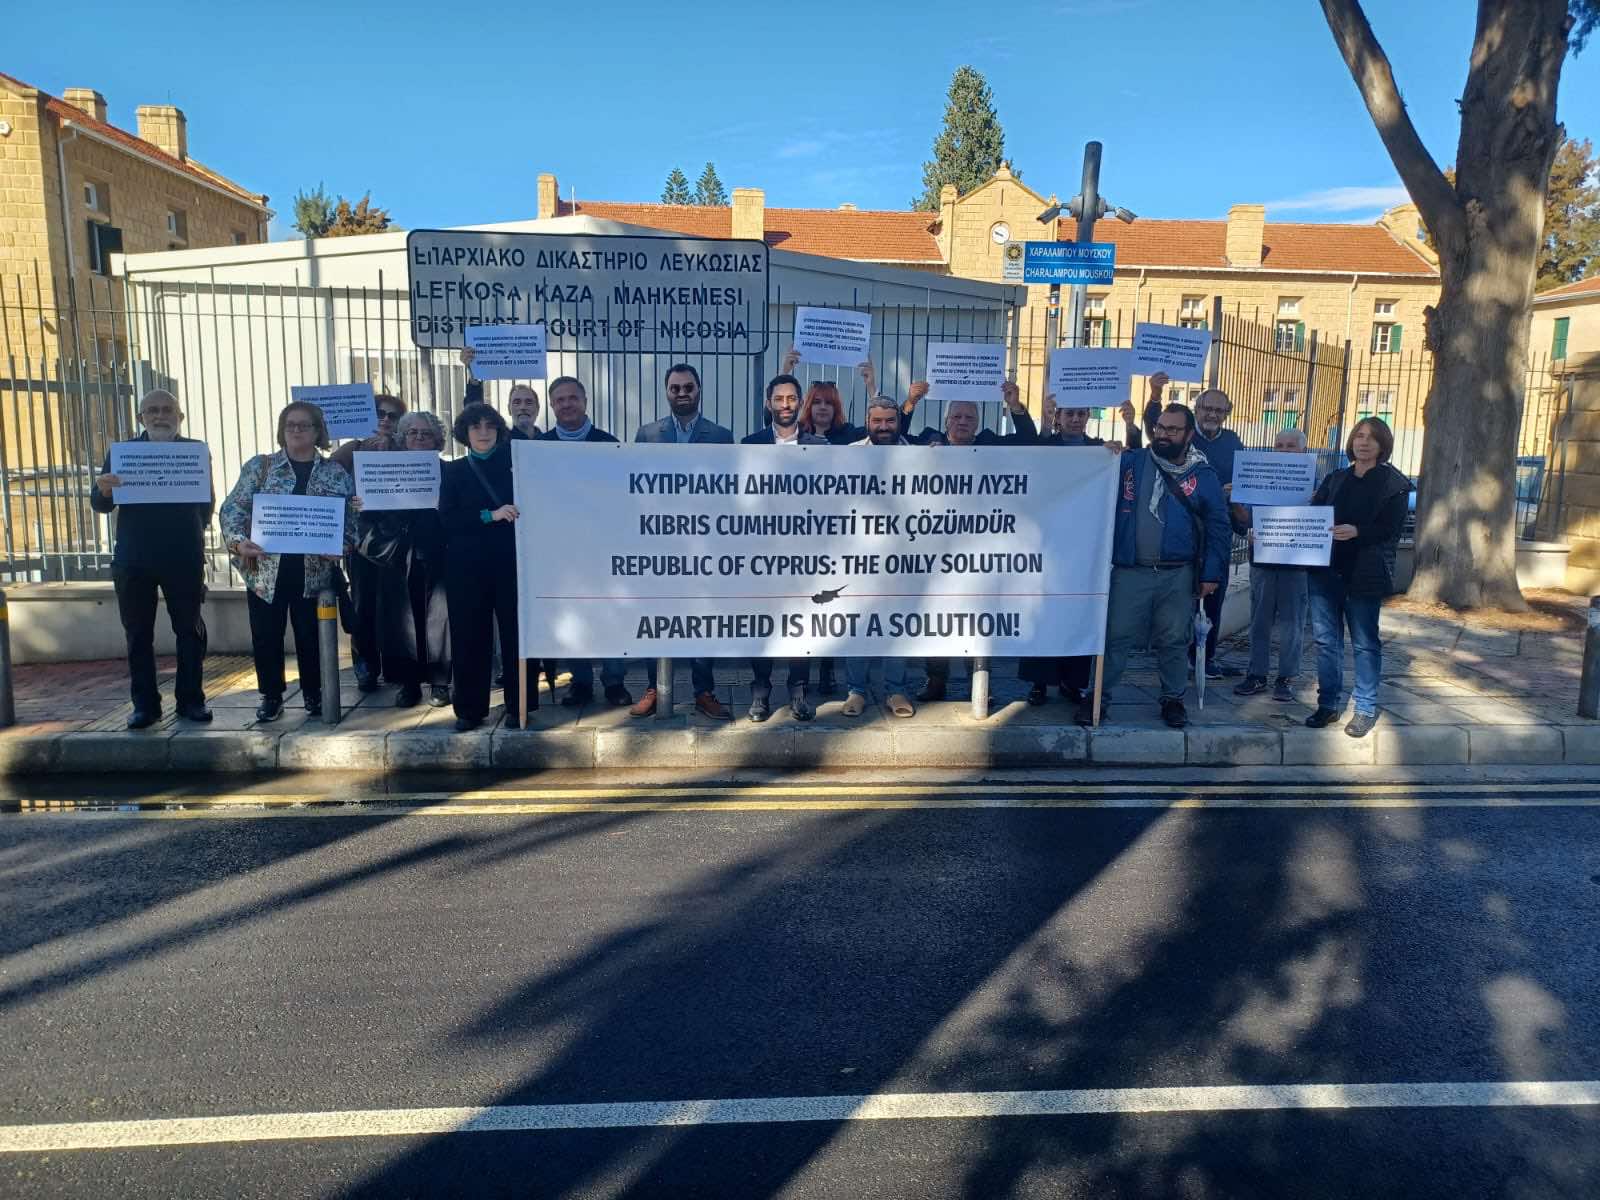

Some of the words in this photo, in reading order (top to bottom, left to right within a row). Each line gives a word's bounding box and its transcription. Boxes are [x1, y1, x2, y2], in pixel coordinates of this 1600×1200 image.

[536, 250, 648, 270] ΔΙΚΑΣΤΗΡΙΟ
[660, 253, 762, 273] ΛΕΥΚΩΣΙΑΣ
[1030, 247, 1076, 258] ΧΑΡΑΛΑΜΠΟΥ
[1080, 248, 1112, 259] ΜΟΥΣΚΟΥ
[1026, 267, 1078, 278] CHARALAMPOU
[1079, 268, 1113, 279] MOUSKOU
[535, 284, 593, 303] KAZA
[614, 286, 742, 306] MAHKEMESI
[617, 319, 645, 337] OF
[660, 321, 748, 339] NICOSIA
[629, 473, 738, 494] ΚΥΠΡΙΑΚΗ
[744, 474, 886, 495] ΔΗΜΟΚΡΑΤΙΑ:
[892, 475, 905, 495] Η
[911, 475, 972, 495] ΜΟΝΗ
[977, 474, 1028, 495] ΛΥΣΗ
[640, 514, 710, 536] KIBRIS
[716, 509, 856, 536] CUMHURİYETİ
[862, 515, 900, 535] TEK
[905, 509, 1016, 541] ÇÖZÜMDÜR
[611, 555, 713, 576] REPUBLIC
[718, 555, 745, 576] OF
[750, 555, 837, 576] CYPRUS:
[842, 555, 880, 575] THE
[885, 554, 937, 574] ONLY
[940, 553, 1043, 574] SOLUTION
[636, 615, 774, 639] APARTHEID
[782, 614, 804, 638] IS
[811, 613, 860, 637] NOT
[866, 613, 884, 636] A
[889, 612, 1020, 638] SOLUTION!
